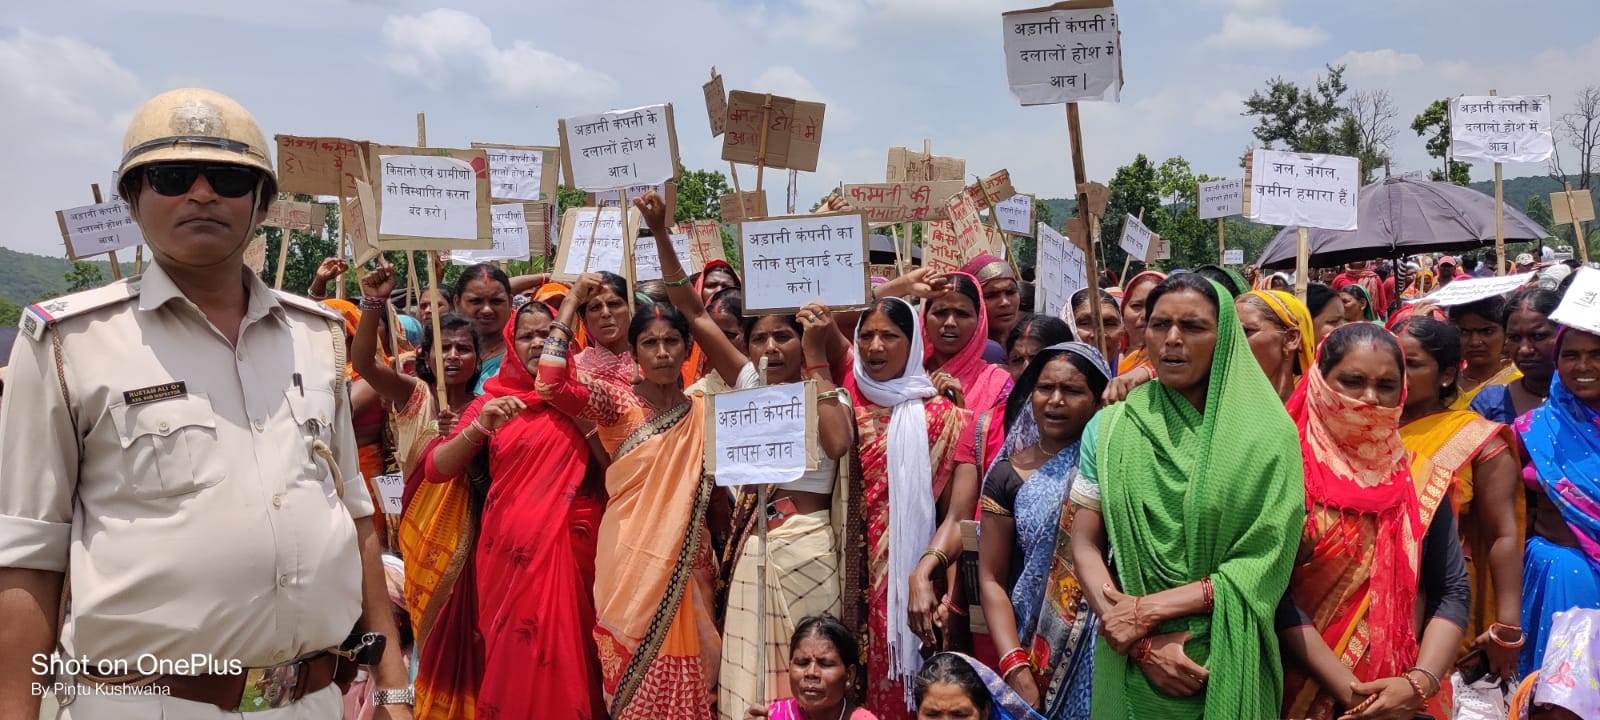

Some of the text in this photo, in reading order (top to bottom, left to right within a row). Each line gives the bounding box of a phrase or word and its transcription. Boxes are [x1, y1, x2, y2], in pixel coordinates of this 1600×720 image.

[1014, 17, 1060, 36] अड़ानी
[1065, 14, 1106, 33] कंपनी
[1019, 43, 1066, 62] दलालों
[1072, 42, 1101, 64] होश
[574, 109, 658, 136] अड़ानी कंपनी के
[1504, 120, 1526, 133] होश
[581, 133, 657, 159] दलालों होश में
[386, 162, 417, 177] किसानों
[419, 165, 433, 180] एवं
[386, 182, 470, 201] को विस्थापित करना
[1256, 181, 1292, 199] जमीन
[1297, 187, 1335, 203] हमारा
[409, 204, 421, 217] बंद
[424, 204, 441, 218] करो
[749, 224, 854, 246] अड़ानी कंपनी का
[752, 250, 853, 274] लोक सुनवाई रद्द
[786, 277, 812, 294] करों
[719, 396, 802, 428] अड़ानी कंपनी
[726, 441, 794, 464] वापस जाव
